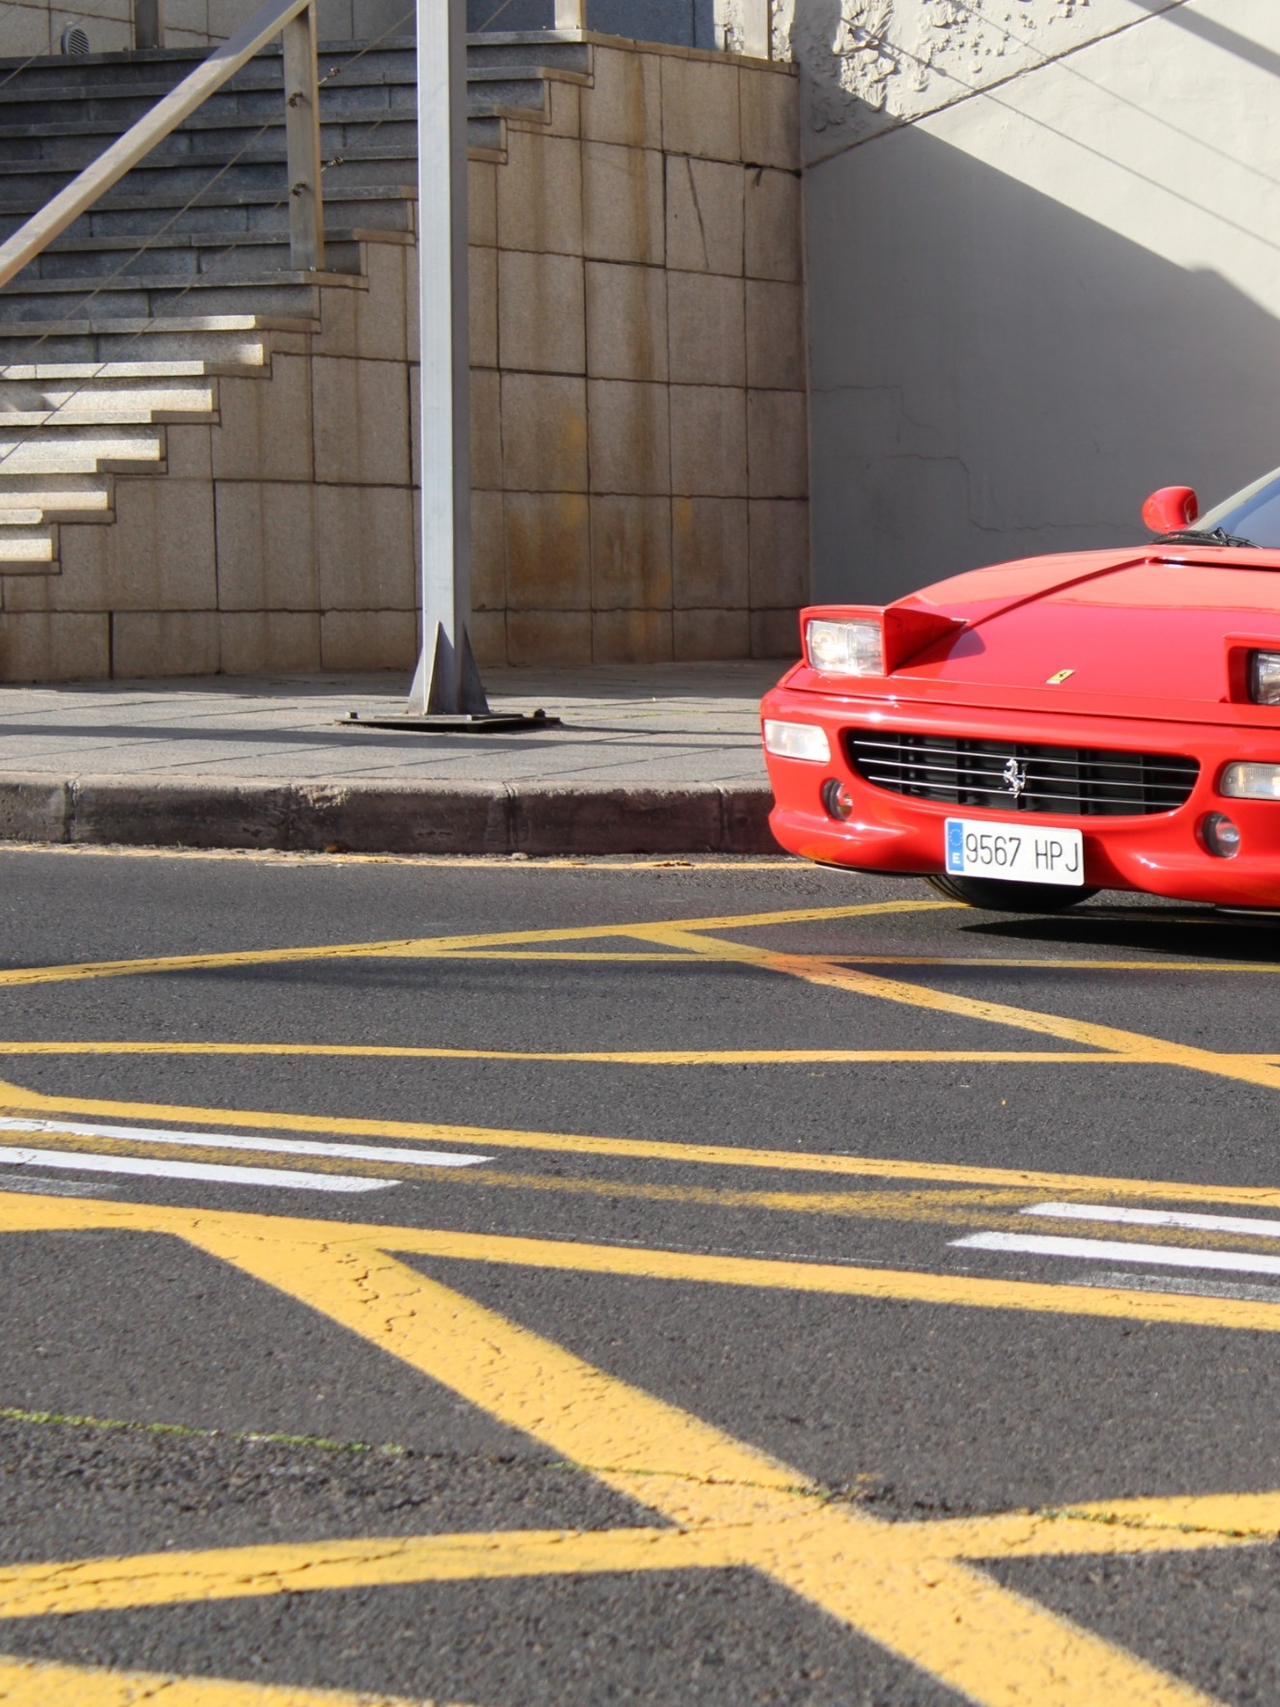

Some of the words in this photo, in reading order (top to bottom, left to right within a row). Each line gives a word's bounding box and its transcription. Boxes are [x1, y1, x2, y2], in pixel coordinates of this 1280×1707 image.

[952, 852, 961, 864] E
[965, 833, 1021, 867] 9567
[1034, 839, 1078, 872] HPJ
